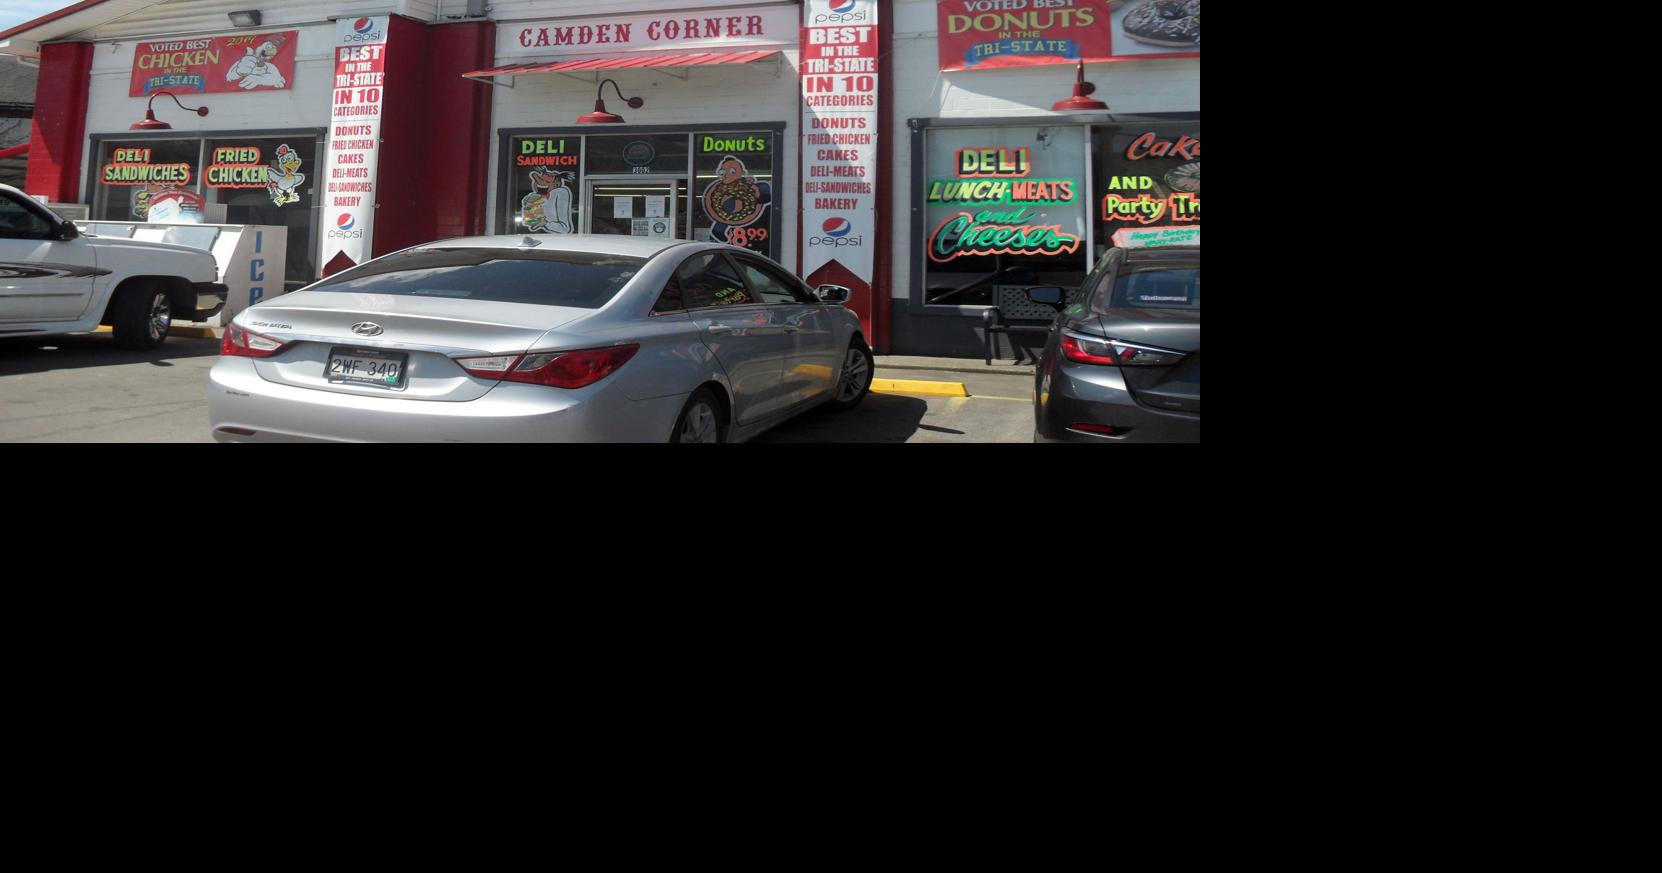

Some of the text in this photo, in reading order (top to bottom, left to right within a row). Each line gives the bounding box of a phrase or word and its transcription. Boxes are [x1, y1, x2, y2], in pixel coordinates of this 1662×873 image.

[964, 0, 1073, 12] VOTED BEST
[815, 10, 866, 24] pepsi
[948, 8, 1095, 33] DONUTS
[344, 31, 380, 44] pepsi
[518, 15, 764, 47] CAMDEN CORNER
[809, 27, 871, 44] BEST
[999, 30, 1041, 39] IN THE
[150, 39, 212, 52] VOTED BEST
[821, 46, 859, 56] IN THE
[974, 41, 1067, 56] TRI-STATE
[138, 49, 220, 69] CHICKEN
[340, 46, 383, 62] BEST
[345, 62, 372, 72] IN THE
[807, 58, 874, 73] TRI-STATE
[150, 75, 200, 87] TRI-STATE
[337, 72, 382, 87] TRI-STATE
[807, 76, 873, 92] IN 10
[335, 88, 380, 104] IN 10
[807, 95, 873, 106] CATEGORIES
[334, 105, 378, 117] CATEGORIES
[812, 118, 866, 128] DONUTS
[335, 125, 371, 136] DONUTS
[332, 140, 374, 150] FRIED CHICKEN
[808, 133, 870, 145] FRIED CHICKEN
[522, 140, 565, 154] DELI
[116, 150, 150, 163] DELI
[216, 149, 258, 163] FRIED
[338, 154, 364, 164] CAKES
[517, 155, 577, 166] SANDWICH
[817, 149, 858, 161] CAKES
[961, 149, 1027, 172] DELI
[104, 165, 188, 183] SANDWICHES
[208, 166, 267, 183] CHICKEN
[332, 168, 368, 178] DELI-MEATS
[811, 166, 865, 177] DELI-MEATS
[328, 182, 372, 192] DELI-SANDWICHES
[805, 182, 871, 194] DELI-SANDWICHES
[1108, 176, 1153, 190] AND
[928, 180, 1075, 201] LUNCH-MEATS
[334, 197, 361, 207] BAKERY
[815, 198, 858, 210] BAKERY
[1107, 195, 1200, 218] Party Tr
[974, 206, 1038, 223] and
[328, 229, 363, 240] pepsi
[938, 215, 1074, 255] Cheeses
[809, 236, 862, 247] pepsi
[332, 358, 398, 377] 2WF 340
